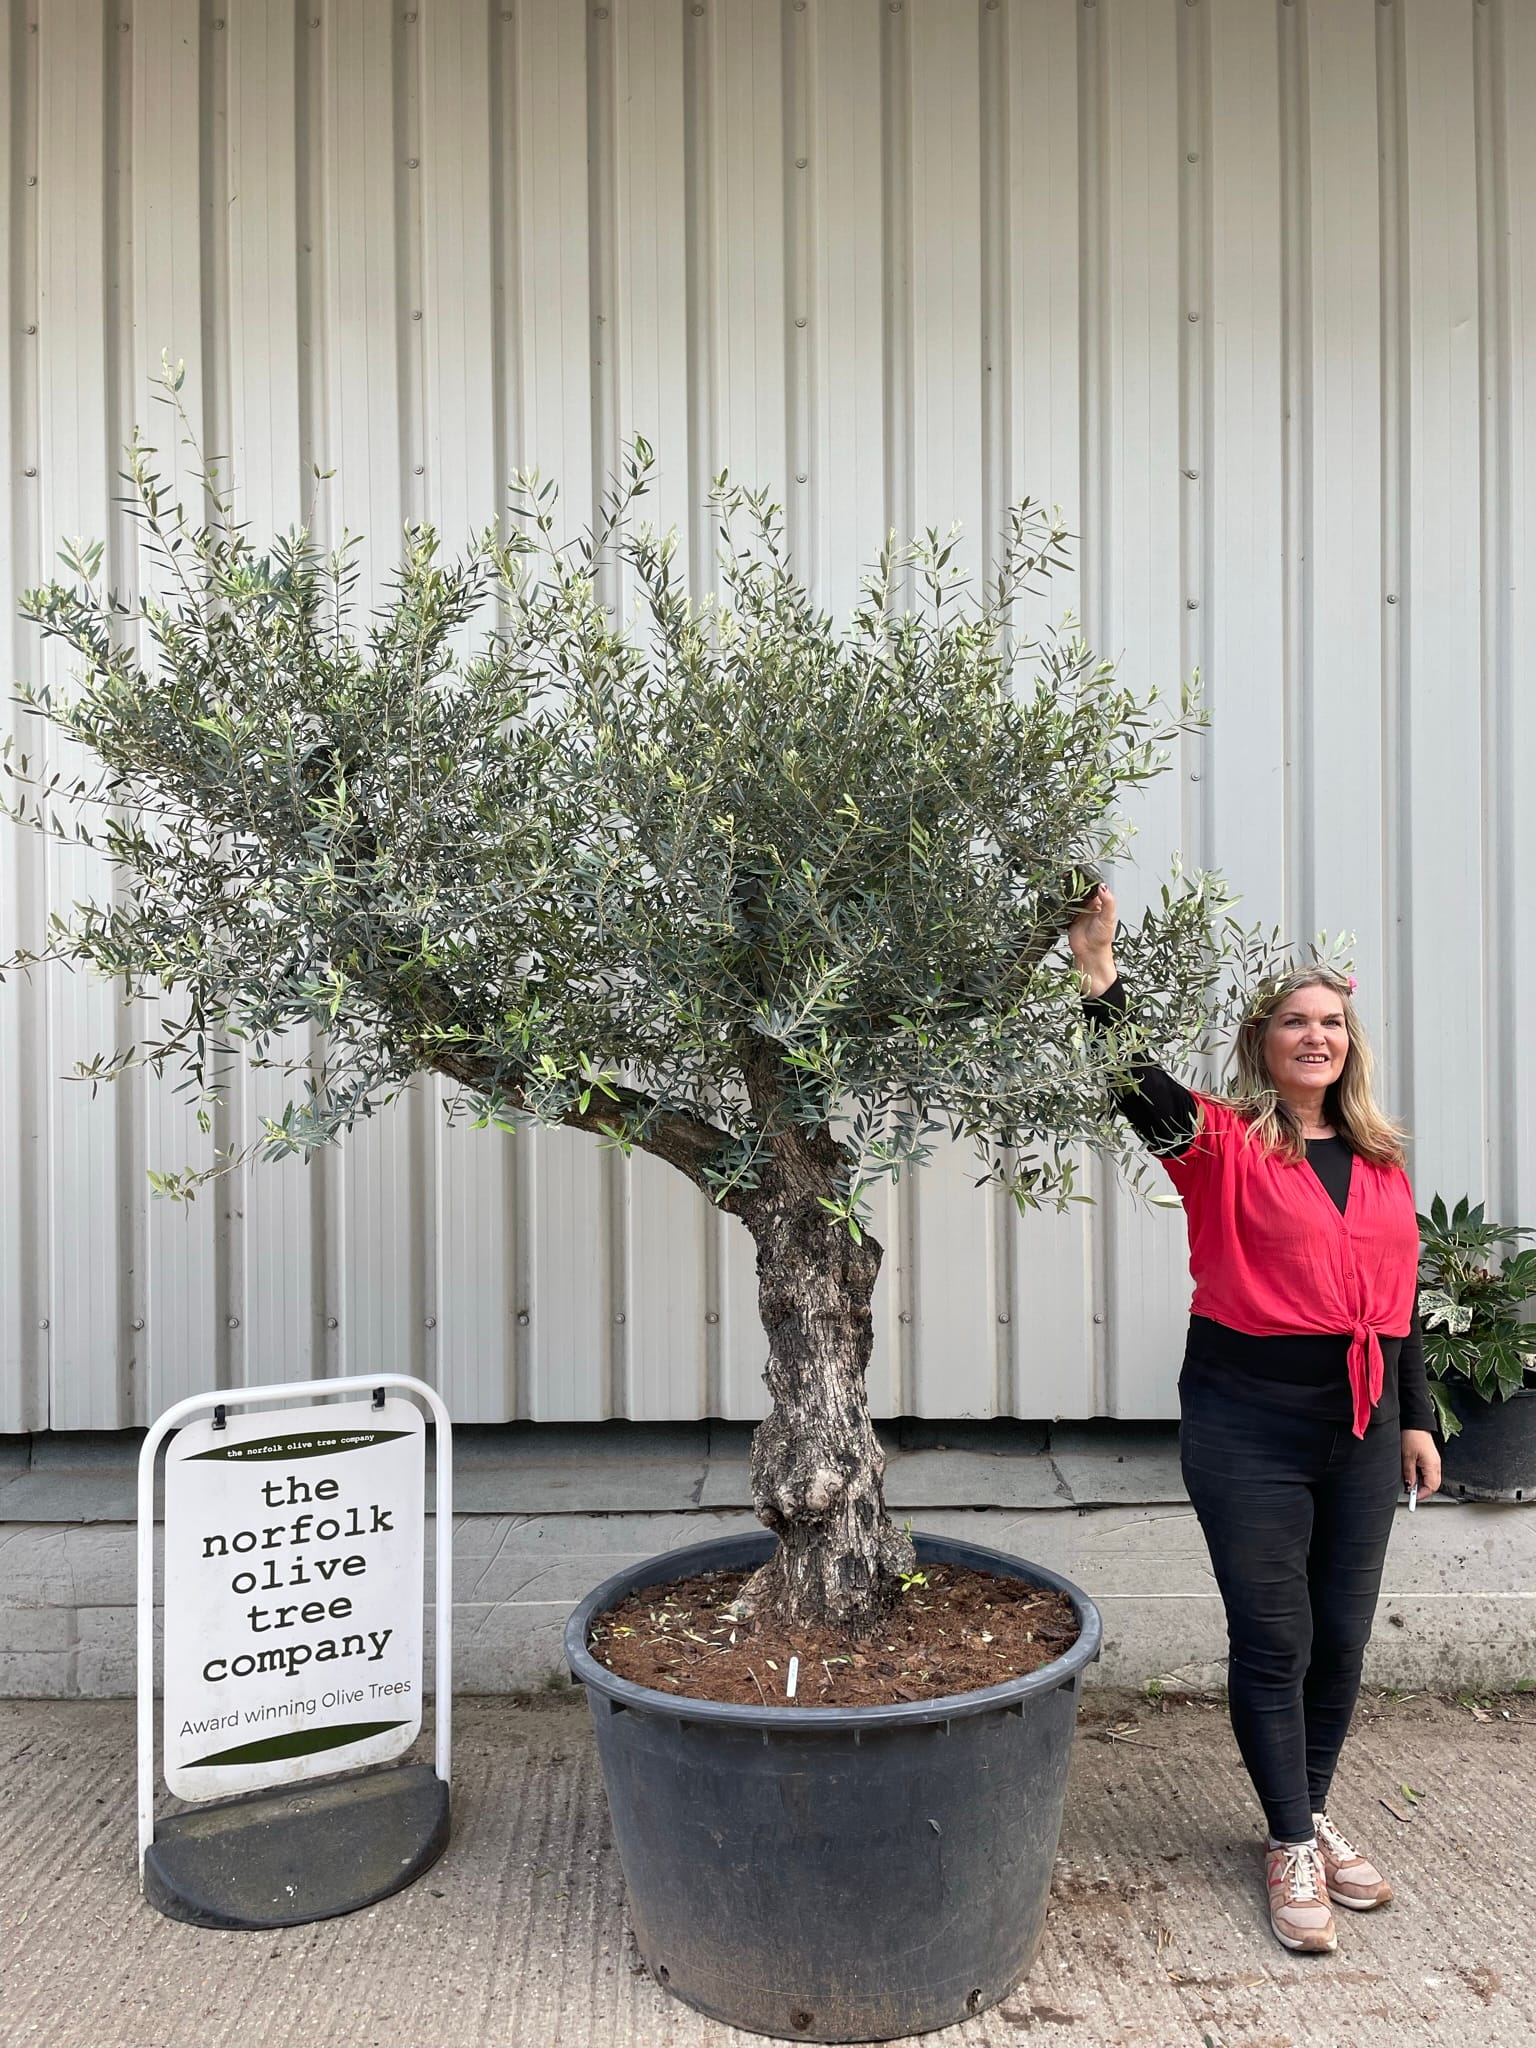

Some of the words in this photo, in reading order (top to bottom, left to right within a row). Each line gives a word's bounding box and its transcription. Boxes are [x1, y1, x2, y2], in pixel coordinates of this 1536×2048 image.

[227, 1449, 243, 1458] the
[246, 1444, 283, 1455] norfolk
[286, 1441, 313, 1450] olive
[316, 1439, 337, 1447] tree
[340, 1434, 375, 1444] company
[261, 1475, 339, 1508] the
[202, 1504, 394, 1558] norfolk
[231, 1555, 366, 1595] olive
[247, 1597, 352, 1633] tree
[202, 1629, 393, 1682] company
[179, 1710, 239, 1737] Award
[244, 1698, 316, 1724] winning
[321, 1689, 364, 1708] Olive
[368, 1680, 412, 1699] Trees
